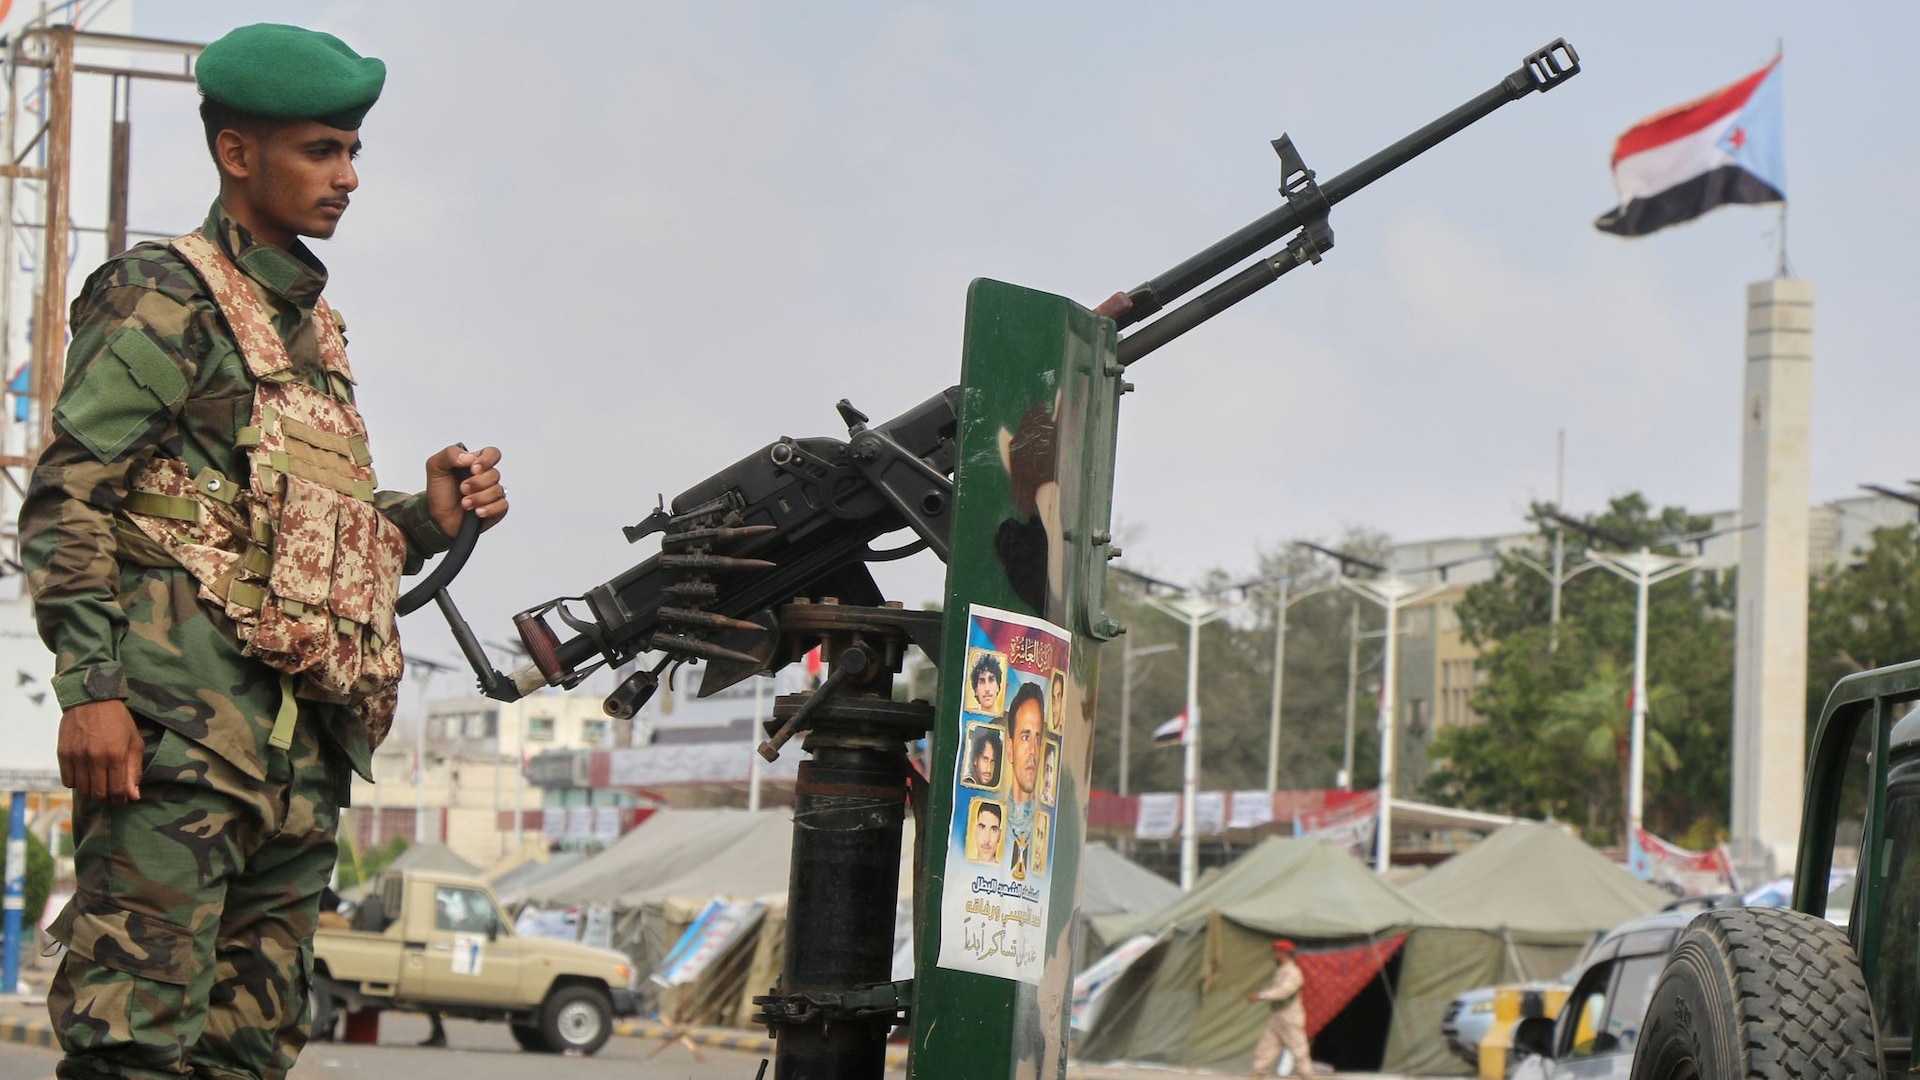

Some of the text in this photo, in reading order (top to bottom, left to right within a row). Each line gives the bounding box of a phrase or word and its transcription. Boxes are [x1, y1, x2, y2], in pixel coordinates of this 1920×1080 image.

[972, 876, 997, 894] البطل
[997, 881, 1022, 898] الشهيد
[965, 898, 1000, 922] ورفاقه
